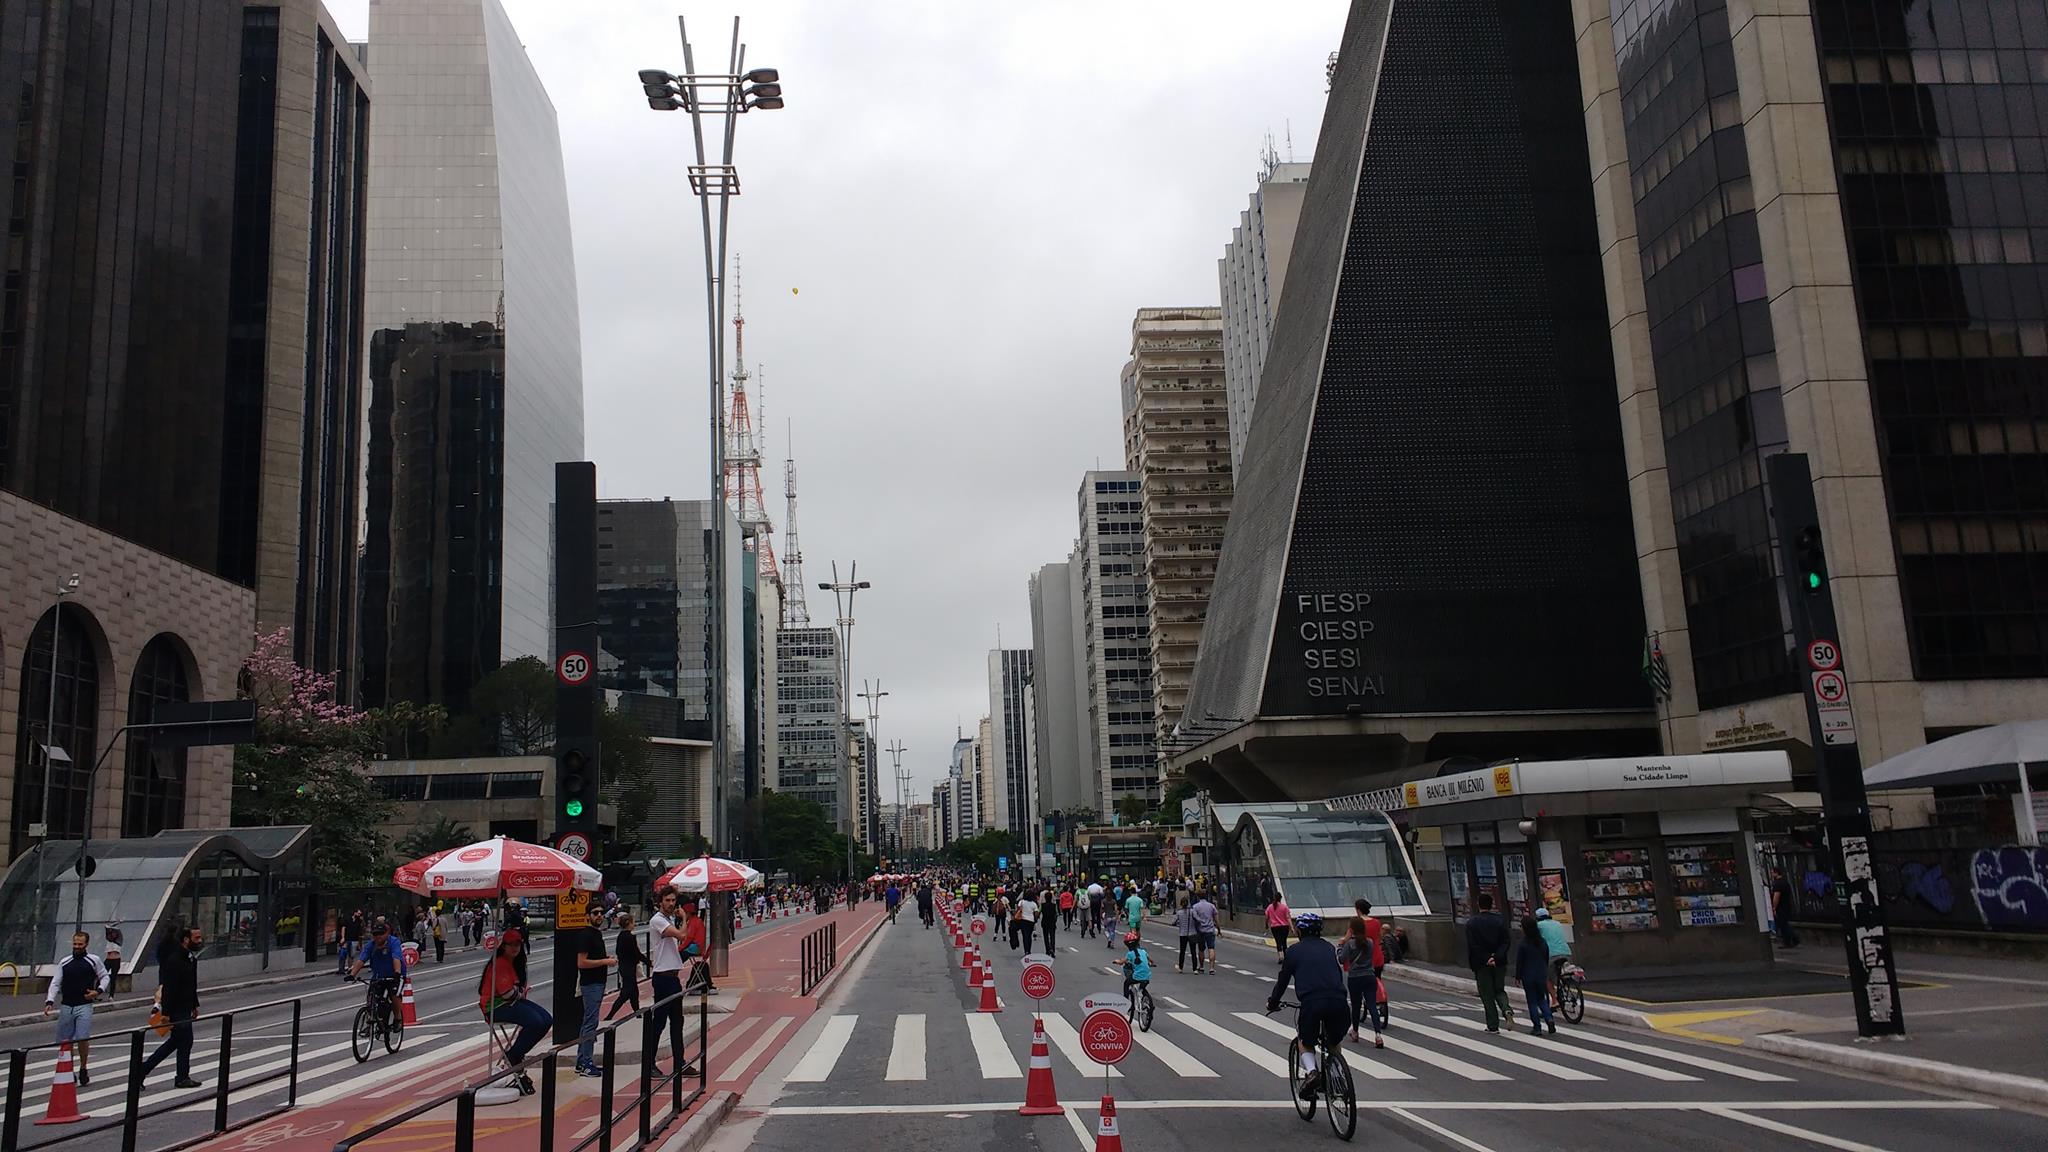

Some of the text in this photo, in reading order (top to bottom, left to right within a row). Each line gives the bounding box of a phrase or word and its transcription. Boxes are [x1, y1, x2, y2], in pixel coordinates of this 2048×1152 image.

[1298, 593, 1371, 613] FIESP
[1300, 620, 1374, 641] CIESP
[1304, 647, 1361, 669] SESI
[1814, 646, 1834, 660] 50
[565, 658, 586, 673] 50
[1307, 676, 1384, 697] SENAI
[1639, 773, 1664, 781] Cidade
[1426, 784, 1447, 799] BANCA
